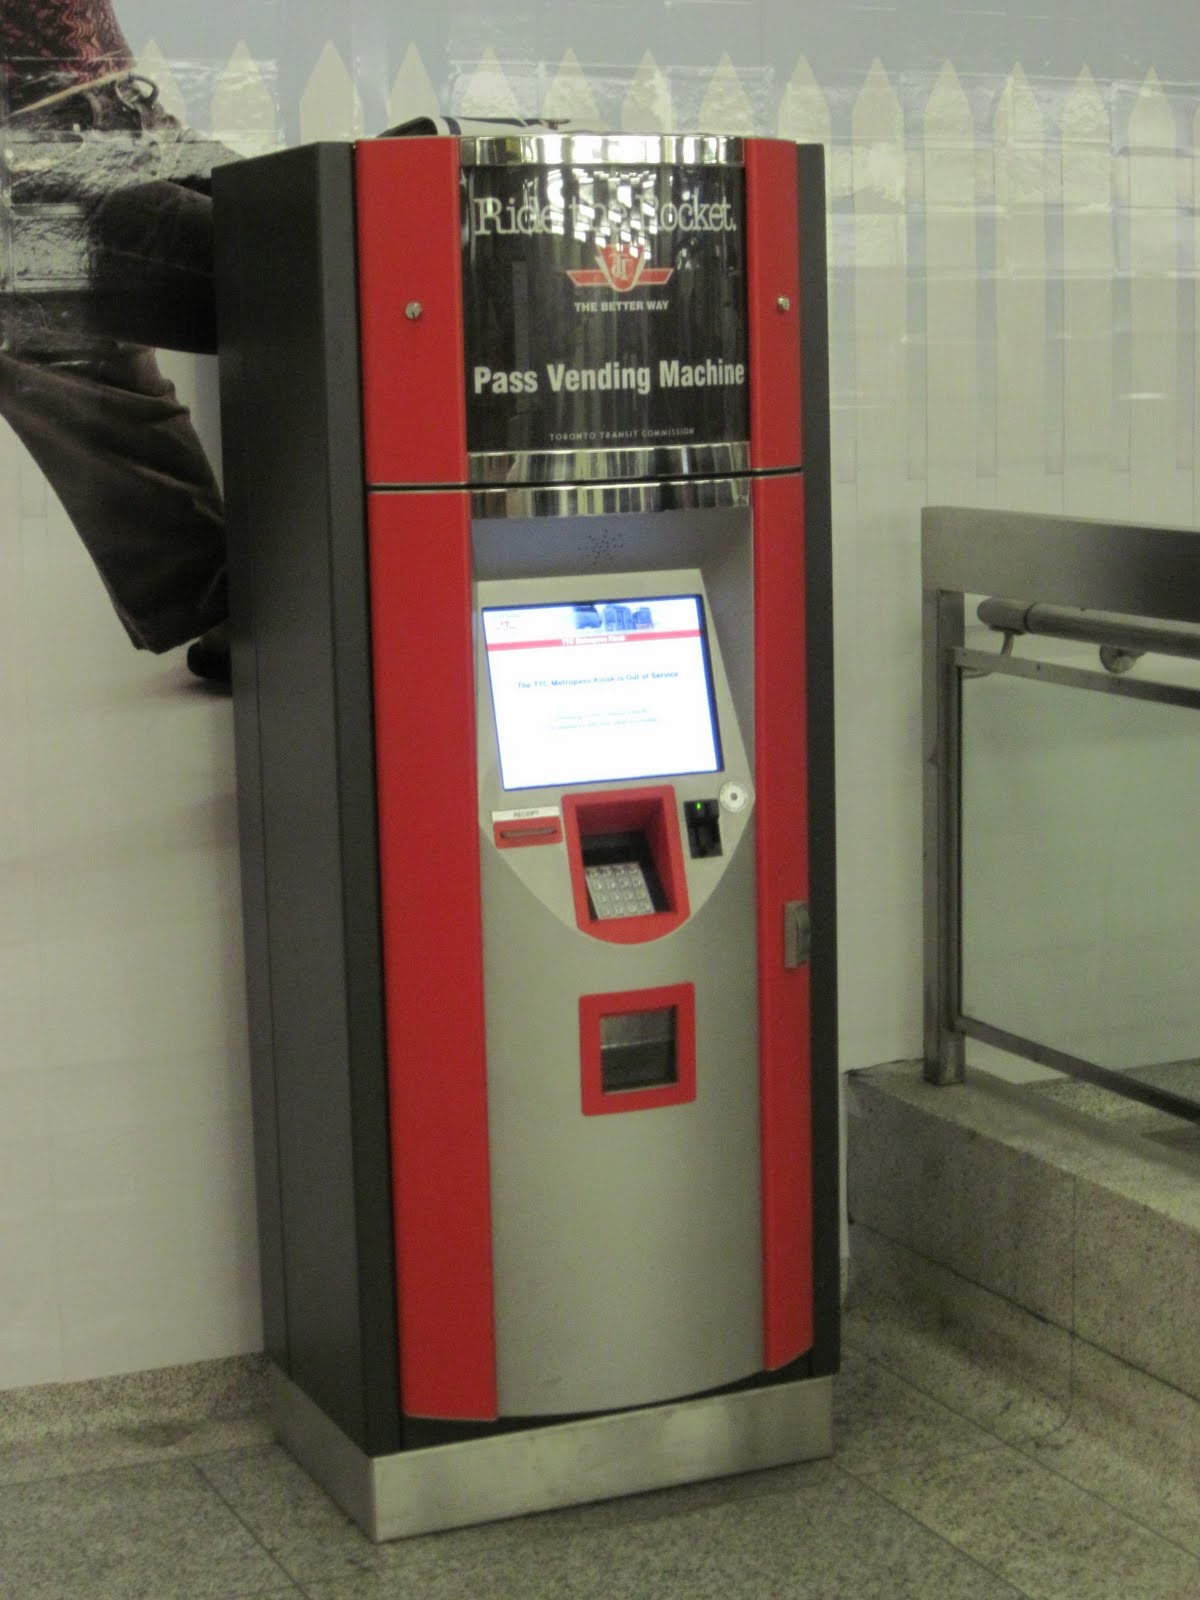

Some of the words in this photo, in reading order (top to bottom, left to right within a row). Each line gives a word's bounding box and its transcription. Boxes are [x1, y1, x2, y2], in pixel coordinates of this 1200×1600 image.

[474, 194, 558, 236] Ride
[574, 302, 597, 313] THE
[601, 301, 644, 312] BETTER
[646, 300, 669, 311] WAY
[474, 366, 538, 394] Pass
[547, 362, 651, 395] Vending
[659, 358, 745, 388] Machine
[549, 432, 596, 441] TORONTO
[600, 430, 638, 439] TRANSIT
[642, 427, 695, 438] COMMISSION
